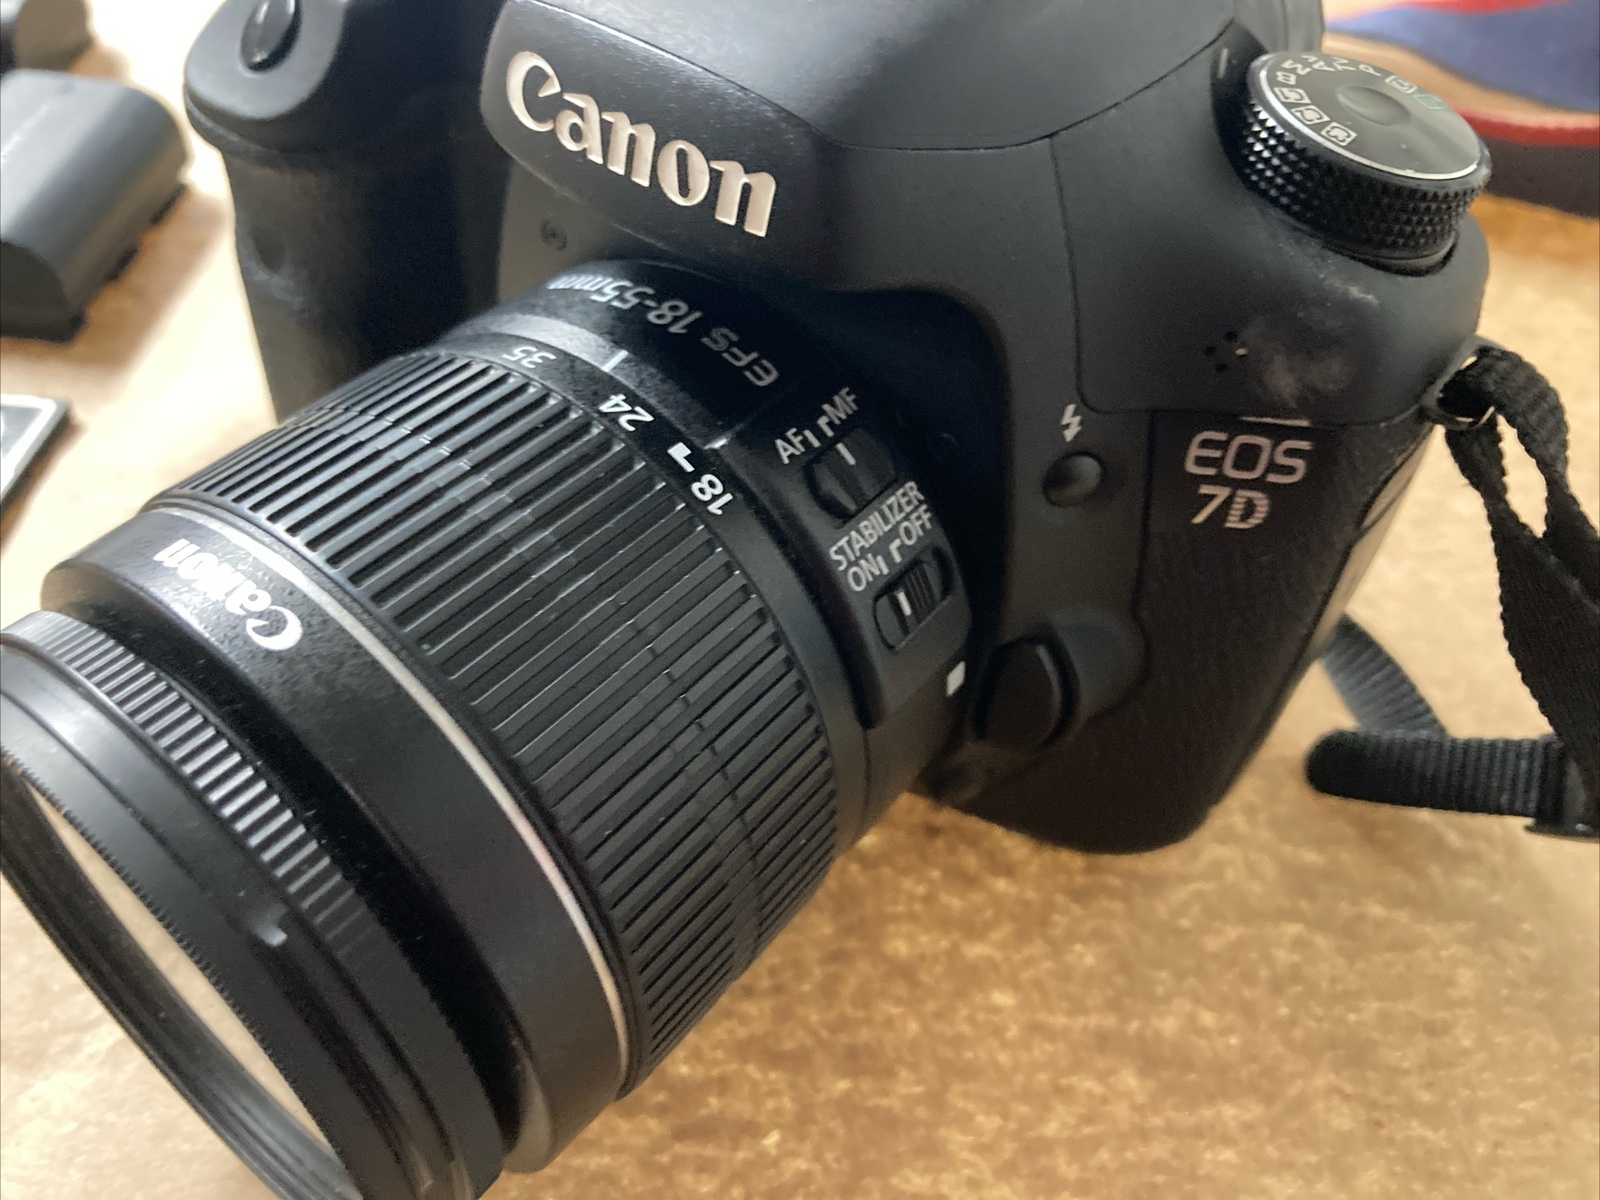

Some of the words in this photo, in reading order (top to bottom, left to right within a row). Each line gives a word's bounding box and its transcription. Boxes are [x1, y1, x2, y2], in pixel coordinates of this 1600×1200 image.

[1281, 59, 1312, 76] M
[1358, 64, 1382, 76] P
[506, 50, 776, 237] Canon
[547, 274, 702, 334] 18-55mm
[502, 345, 557, 369] 35
[700, 327, 780, 386] EFS
[600, 394, 655, 431] 24
[774, 427, 806, 465] AF
[821, 387, 859, 425] MF
[1184, 430, 1315, 484] EOS
[691, 473, 733, 515] 18
[1191, 484, 1270, 529] 7D
[828, 480, 925, 571] STABILIZER
[846, 553, 881, 592] ON
[898, 504, 933, 547] OFF
[153, 538, 303, 650] Canon
